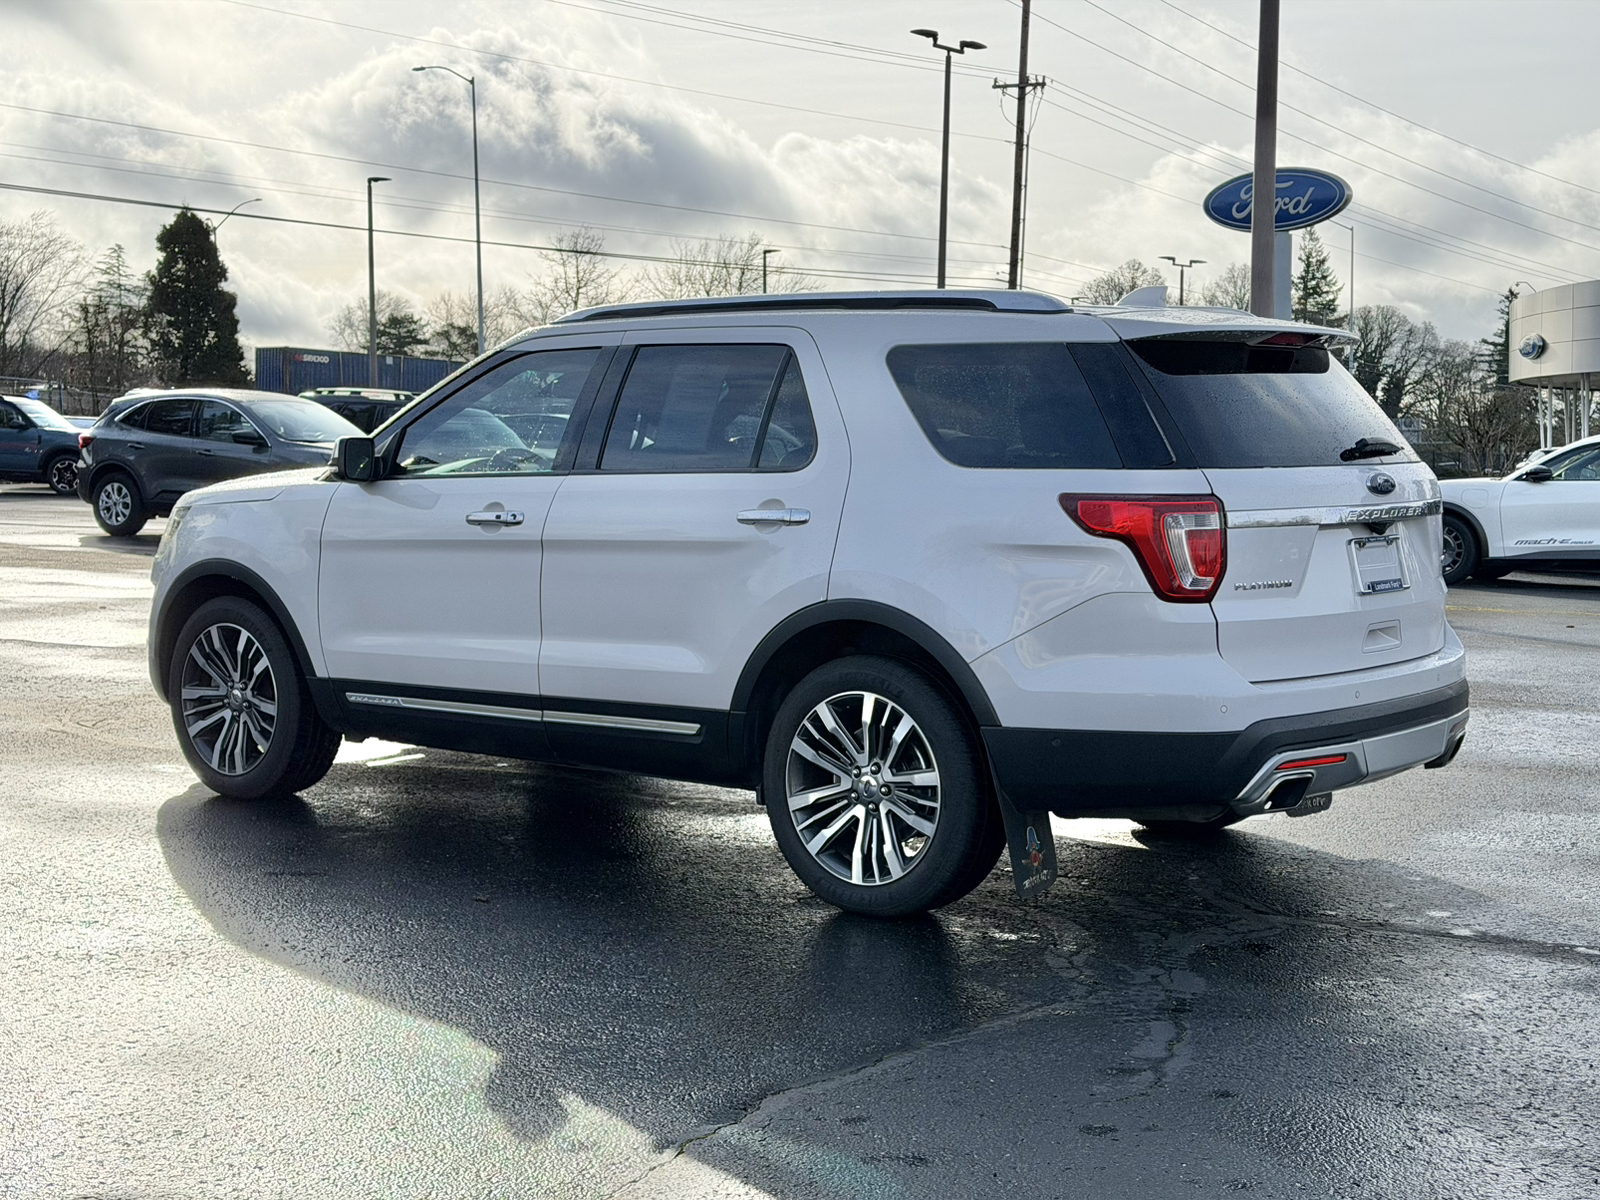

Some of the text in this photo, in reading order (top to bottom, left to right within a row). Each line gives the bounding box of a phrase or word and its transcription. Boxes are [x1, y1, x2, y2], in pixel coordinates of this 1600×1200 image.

[1232, 181, 1315, 220] Frd
[1347, 506, 1423, 521] EXPLORER
[1234, 579, 1293, 591] PLATINUM
